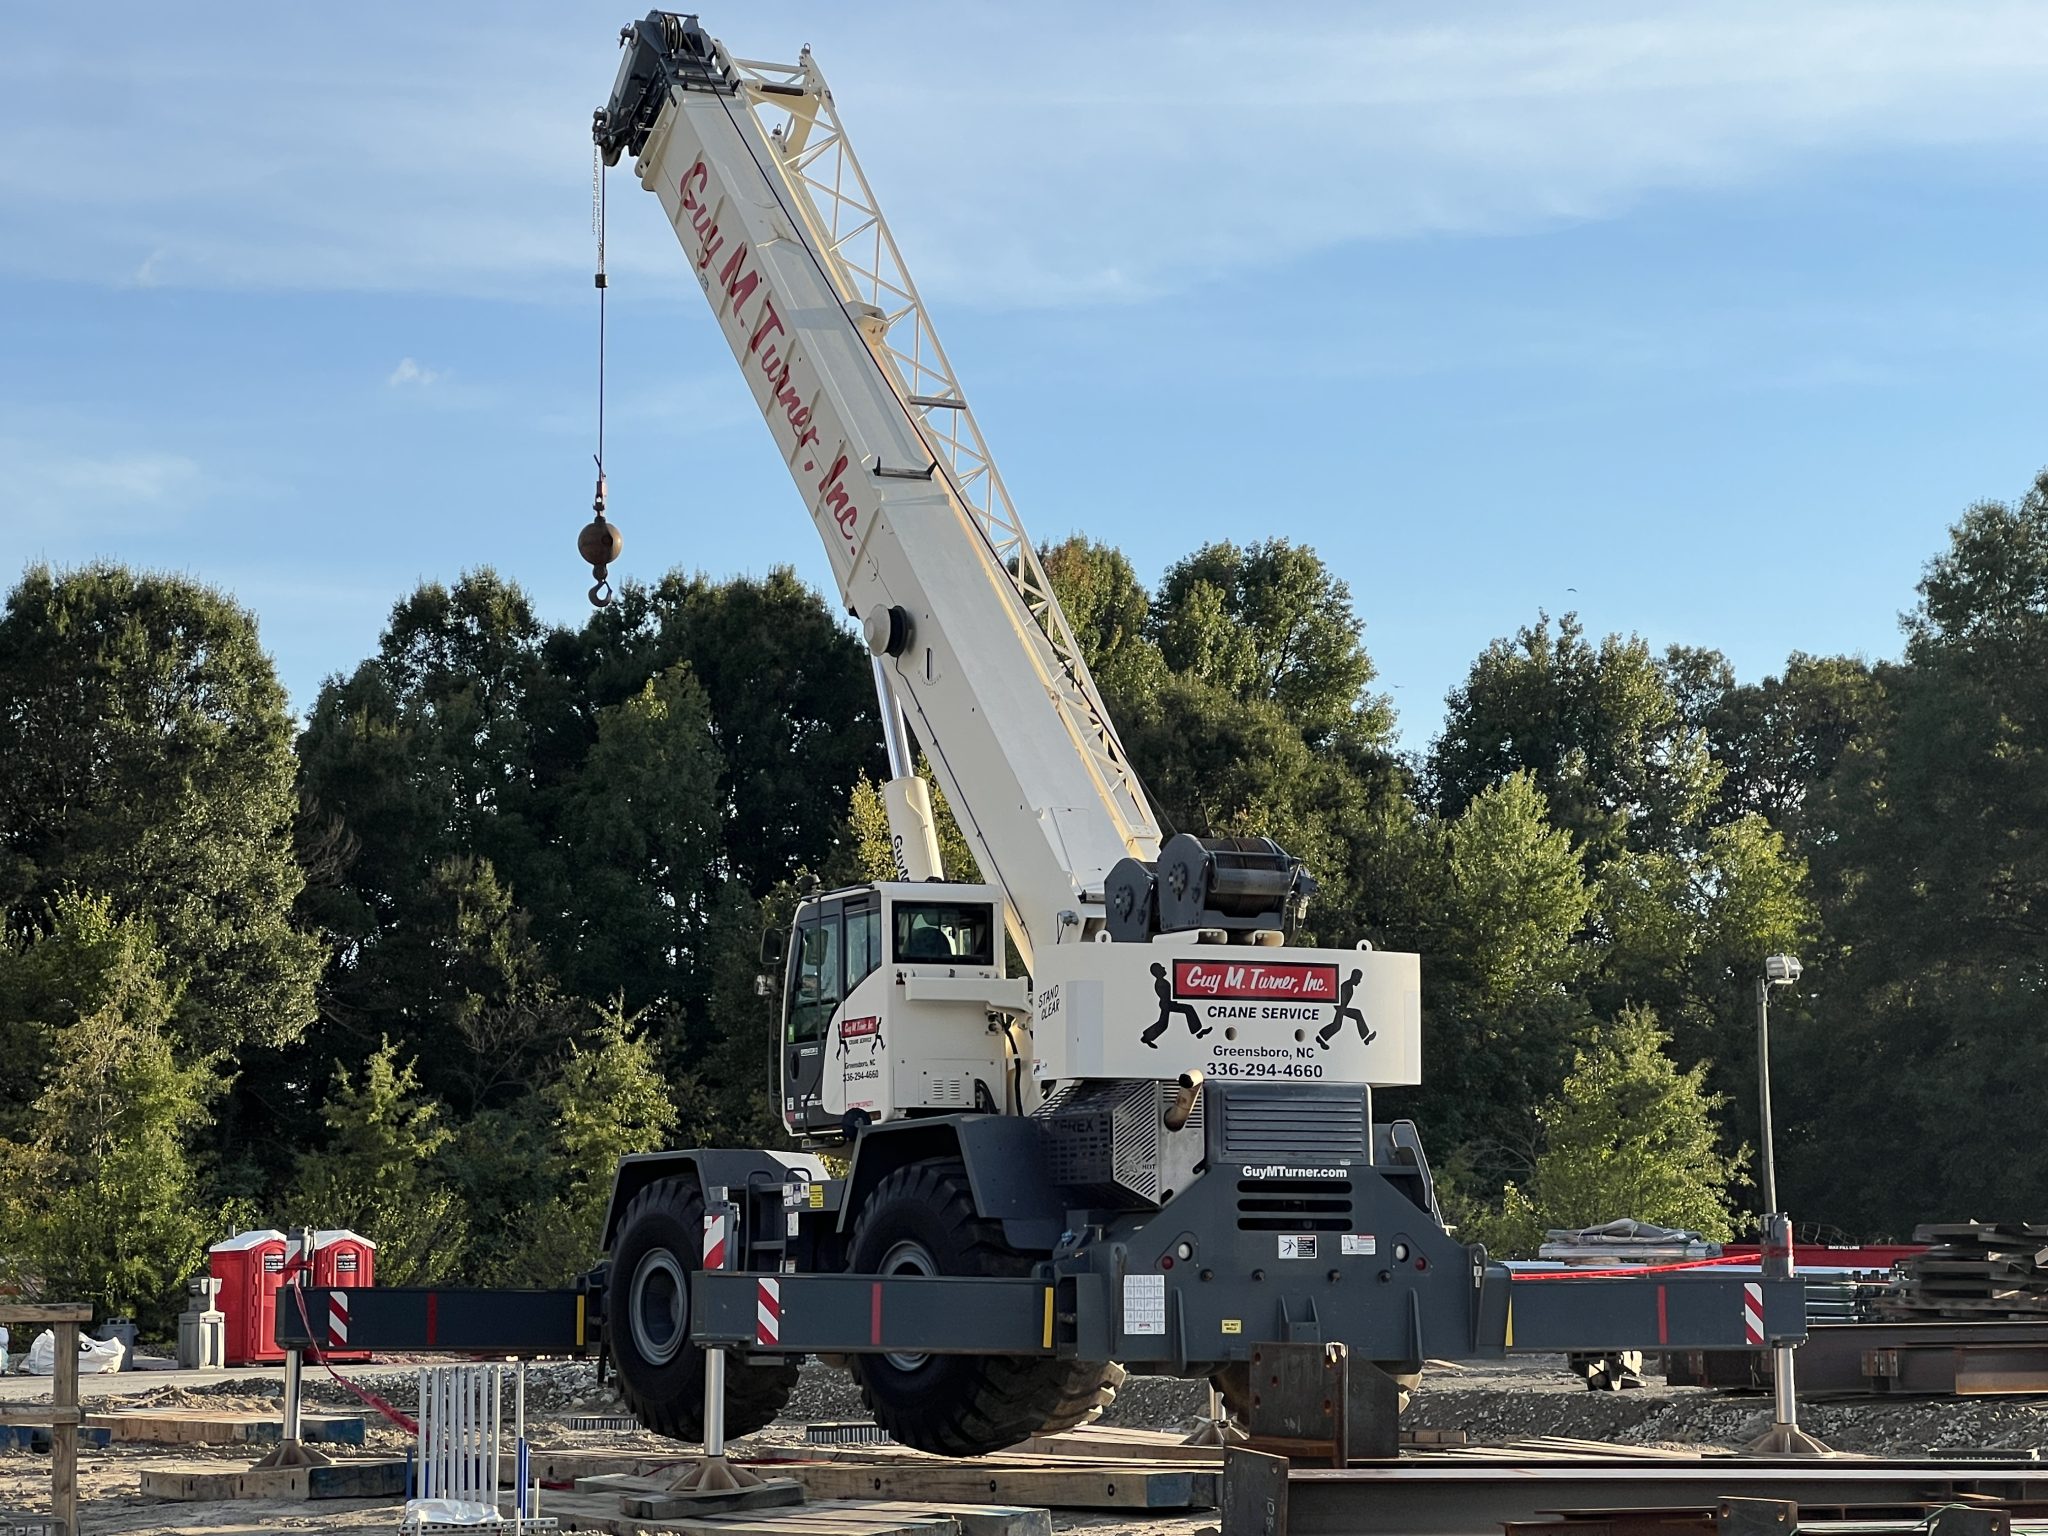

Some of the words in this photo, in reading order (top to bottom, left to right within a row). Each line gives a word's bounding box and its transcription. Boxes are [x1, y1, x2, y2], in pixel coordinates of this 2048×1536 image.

[680, 162, 724, 269] Guy
[818, 455, 857, 556] Inc.
[1186, 966, 1221, 994] Guy
[1224, 966, 1246, 990] M.
[1250, 969, 1299, 994] Turner,
[1302, 971, 1328, 992] Inc.
[1038, 984, 1060, 1008] STAND
[1041, 998, 1061, 1020] CLEAR
[1207, 1006, 1257, 1018] CRANE
[1261, 1007, 1320, 1020] SERVICE
[1213, 1045, 1293, 1060] Greensboro,
[1296, 1047, 1315, 1058] NC
[1206, 1062, 1323, 1078] 336-294-4660
[1242, 1165, 1348, 1180] GuyMTurner.com
